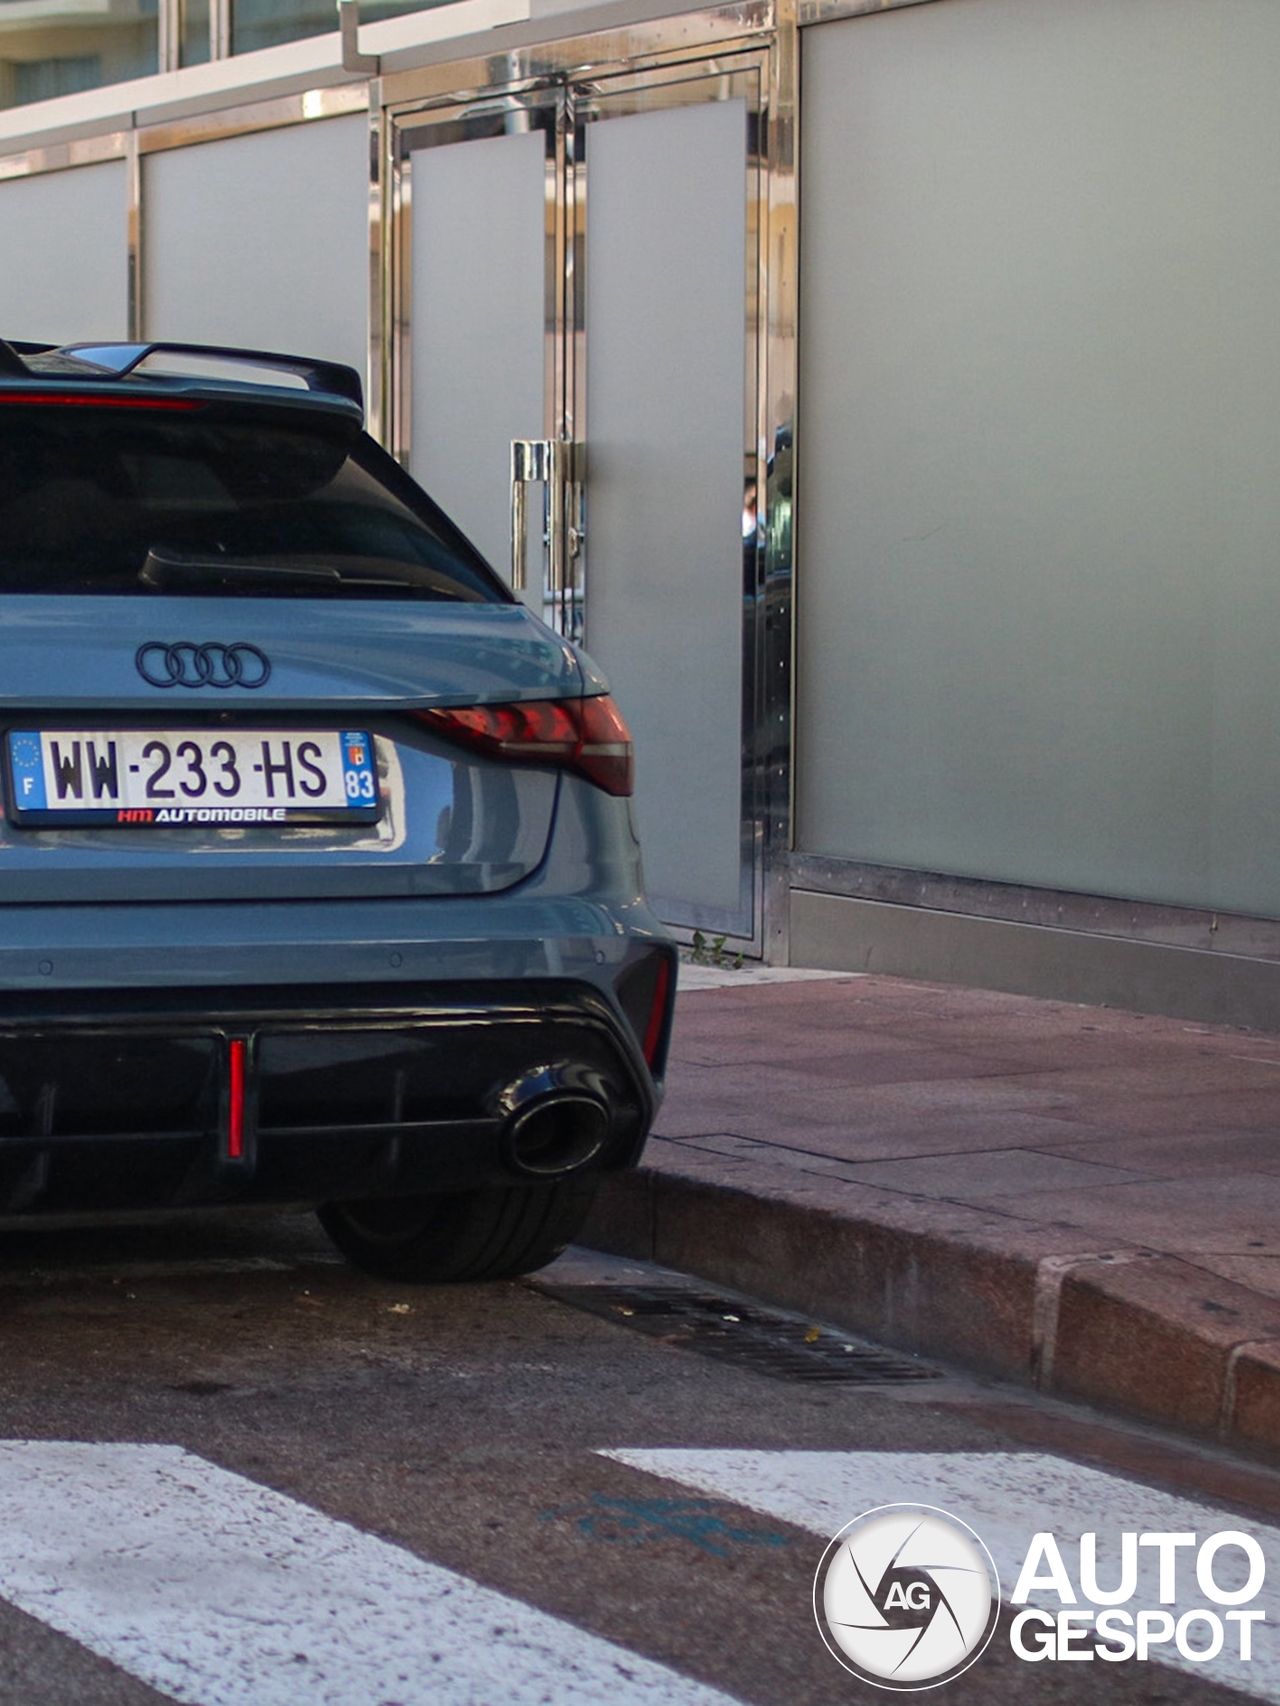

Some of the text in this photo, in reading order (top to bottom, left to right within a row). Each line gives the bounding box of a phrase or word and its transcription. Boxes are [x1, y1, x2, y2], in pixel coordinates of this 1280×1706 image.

[23, 778, 34, 795] F
[345, 770, 375, 798] 83
[155, 808, 286, 822] AUTOMOBILE
